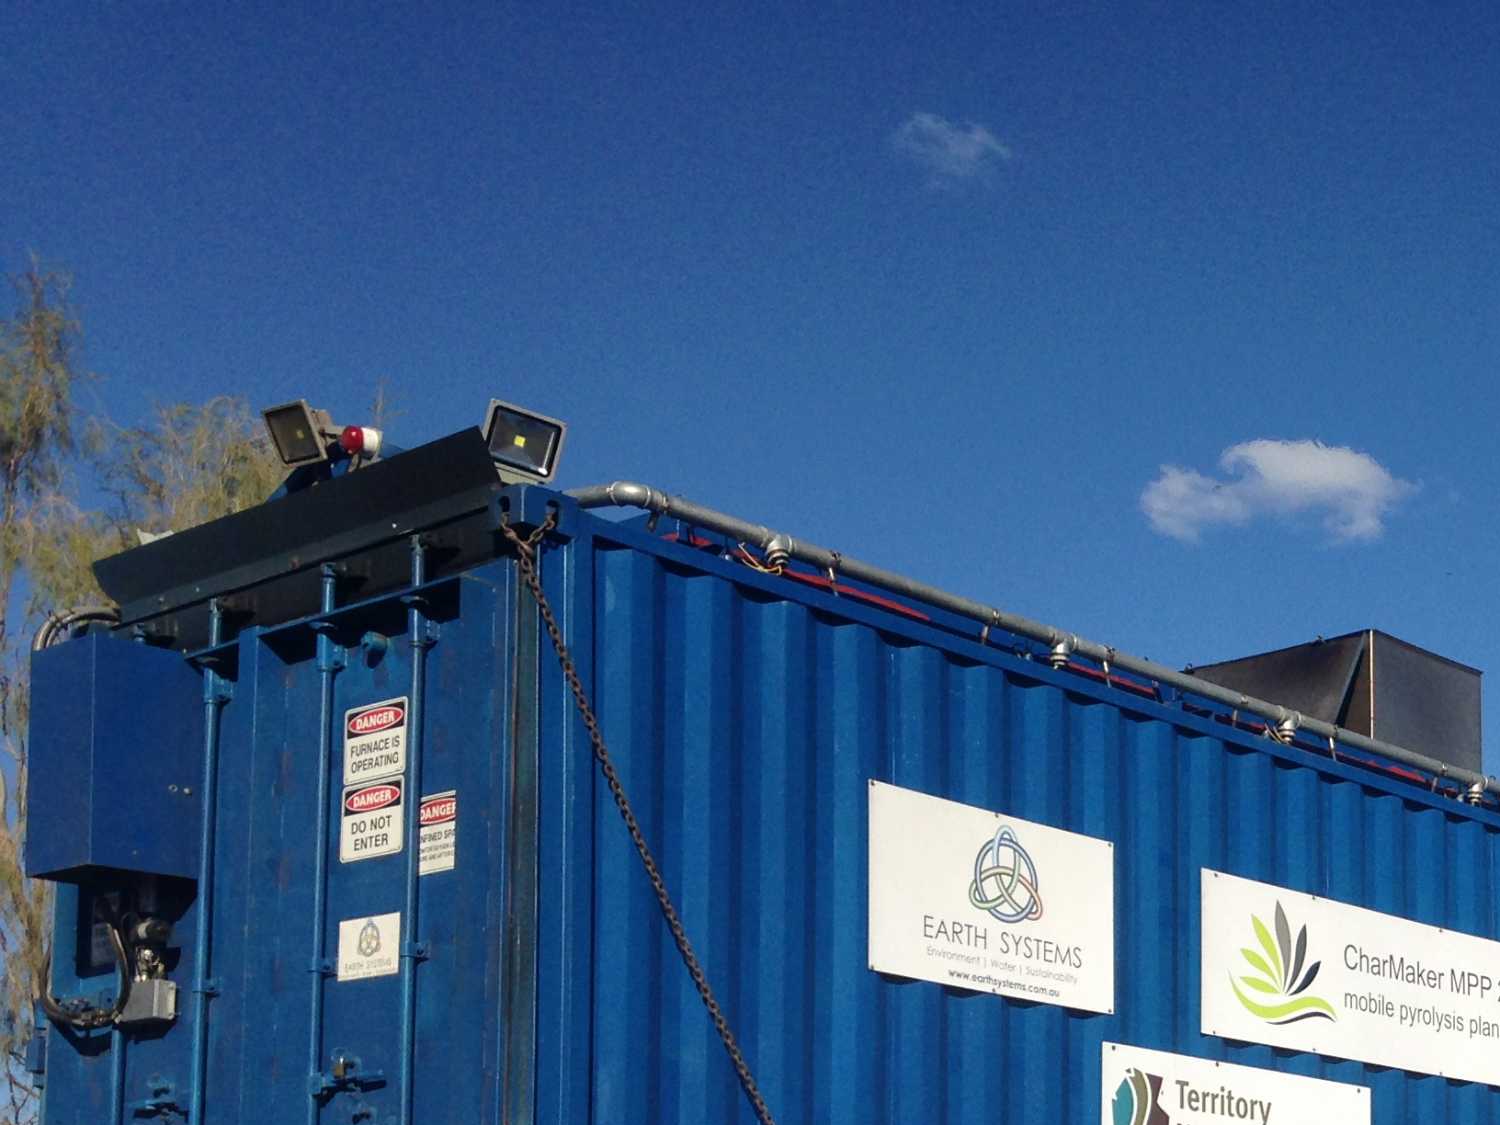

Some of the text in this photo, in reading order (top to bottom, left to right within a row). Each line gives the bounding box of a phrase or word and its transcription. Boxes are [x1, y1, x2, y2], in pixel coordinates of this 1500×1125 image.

[356, 710, 395, 730] DANGER
[350, 735, 400, 758] FURNACE IS
[351, 752, 399, 774] OPERATING
[353, 789, 392, 809] DANGER
[351, 815, 392, 835] DO NOT
[354, 833, 388, 851] ENTER
[923, 915, 1082, 969] EARTH SYSTEMS
[927, 945, 1079, 984] Environment Water Sustainability
[1343, 944, 1445, 990] CharMaker
[1450, 968, 1492, 999] MPP
[948, 968, 1060, 998] www.earthsystems.com.au
[1344, 991, 1395, 1018] mobile
[1400, 1003, 1464, 1033] pyrolysis
